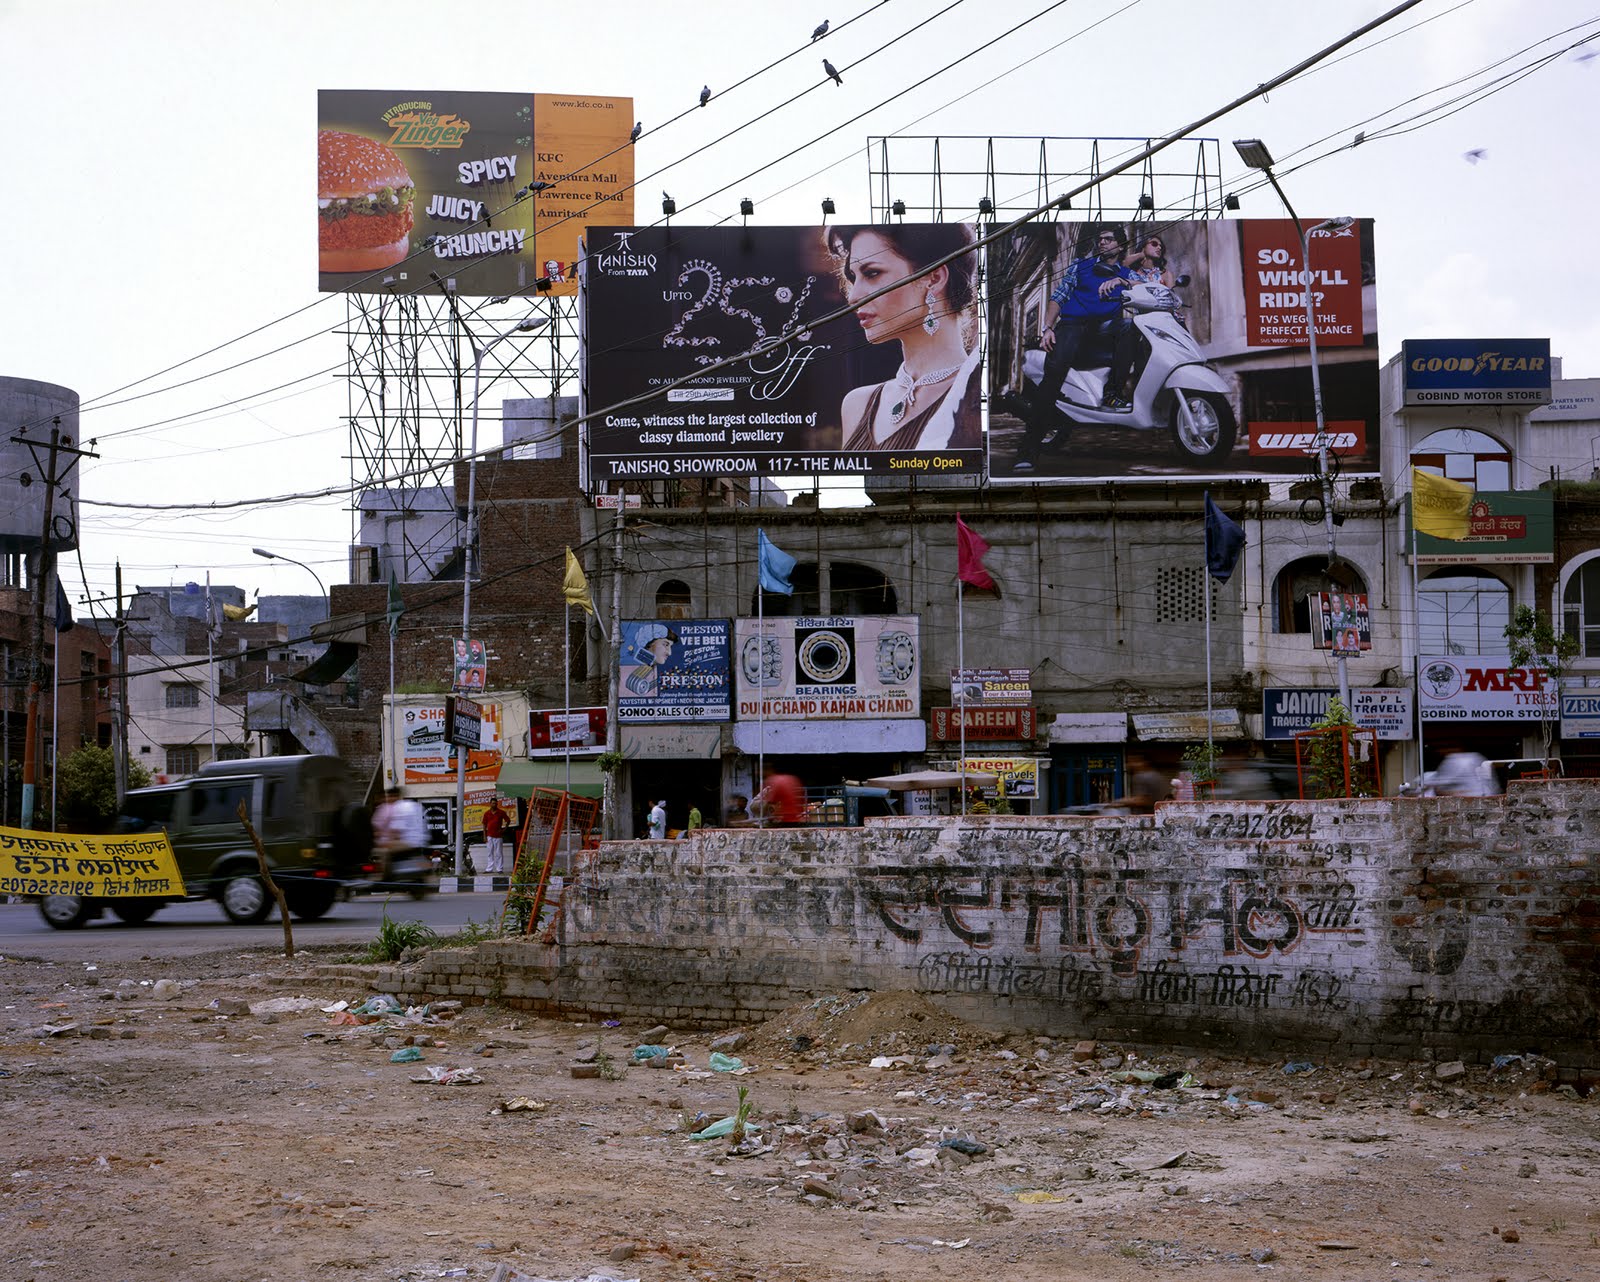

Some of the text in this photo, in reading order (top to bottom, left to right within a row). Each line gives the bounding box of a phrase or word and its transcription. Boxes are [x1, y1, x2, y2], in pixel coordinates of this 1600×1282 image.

[552, 100, 614, 110] www.kfc.co.in
[381, 101, 432, 123] INTRODUCING
[417, 112, 440, 127] Veg
[395, 120, 469, 146] Zinger
[537, 152, 564, 164] KFC
[458, 154, 518, 185] SPICY
[537, 172, 618, 184] Aventura Mall
[537, 190, 625, 202] Lawrence Road
[425, 195, 483, 222] JUICY
[537, 208, 589, 219] Amritsar
[434, 229, 526, 259] CRUNCHY
[1258, 249, 1296, 267] SO,
[1258, 270, 1349, 287] WHO'LL
[1259, 291, 1325, 309] RIDE?
[1259, 314, 1337, 324] TVS WEG THE
[1260, 325, 1353, 335] PERFECT BALANCE
[749, 336, 832, 401] Off
[716, 376, 752, 385] JEWELLERY
[703, 390, 730, 399] August
[1416, 391, 1542, 401] GOBIND MOTOR STORE
[605, 412, 818, 429] Come, witness the largest collection of
[639, 430, 785, 445] classy diamond jewellery
[609, 460, 671, 475] TANISHQ
[673, 458, 758, 472] SHOWROOM
[833, 456, 873, 471] MALL
[889, 457, 930, 470] Sunday
[930, 456, 963, 469] Open
[681, 625, 725, 634] PRESTON
[680, 636, 727, 645] VEE BELT
[661, 675, 723, 686] PRESTON
[984, 681, 1029, 691] Sareen
[1463, 668, 1549, 692] MRF
[795, 686, 857, 695] BEARINGS
[1514, 693, 1557, 705] TYRES
[619, 708, 655, 717] SONOO
[656, 707, 681, 717] SALES
[683, 706, 705, 717] CORP.
[740, 699, 914, 715] DUNI CHAND KAHAN CHAND
[1354, 704, 1406, 714] TRAVELS
[1565, 698, 1600, 713] ZER
[951, 711, 1017, 727] SAREEN
[1421, 709, 1558, 718] GOBIND MOTOR STORE
[1271, 716, 1312, 727] TRAVELS
[458, 727, 477, 740] AUTOS
[996, 770, 1035, 779] Travels
[469, 791, 498, 799] INTRODU
